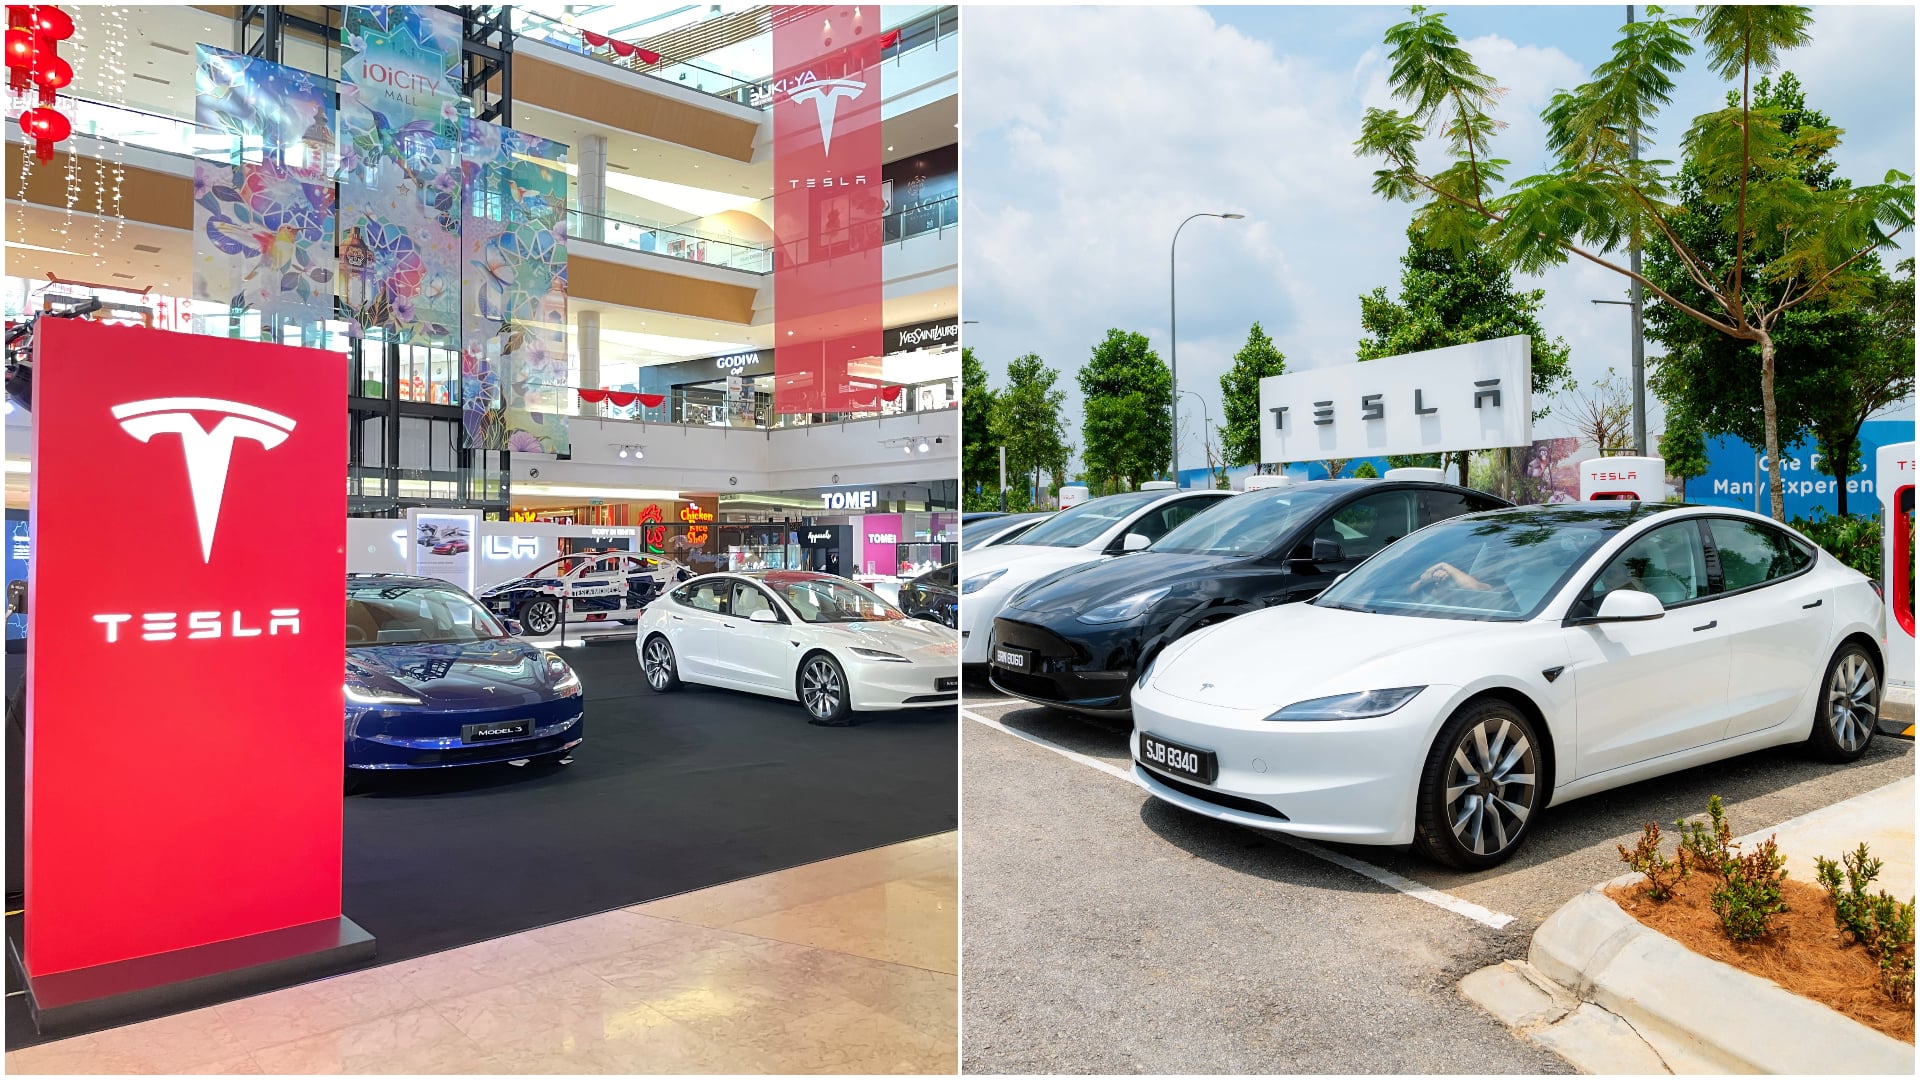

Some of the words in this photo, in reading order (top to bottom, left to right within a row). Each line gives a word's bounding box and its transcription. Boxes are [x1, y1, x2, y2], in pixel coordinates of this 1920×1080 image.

[384, 89, 419, 106] MALL
[788, 175, 866, 189] TESLA
[716, 352, 760, 369] GODIVA
[1269, 378, 1501, 430] TESLA
[1591, 471, 1637, 481] TESLA
[821, 490, 878, 510] TOMEI
[680, 507, 714, 521] Chicken
[868, 533, 897, 544] TOMEI
[91, 608, 301, 643] TESLA
[478, 727, 514, 736] MODEL
[1146, 739, 1166, 764] SJB
[1167, 747, 1198, 774] 8340
